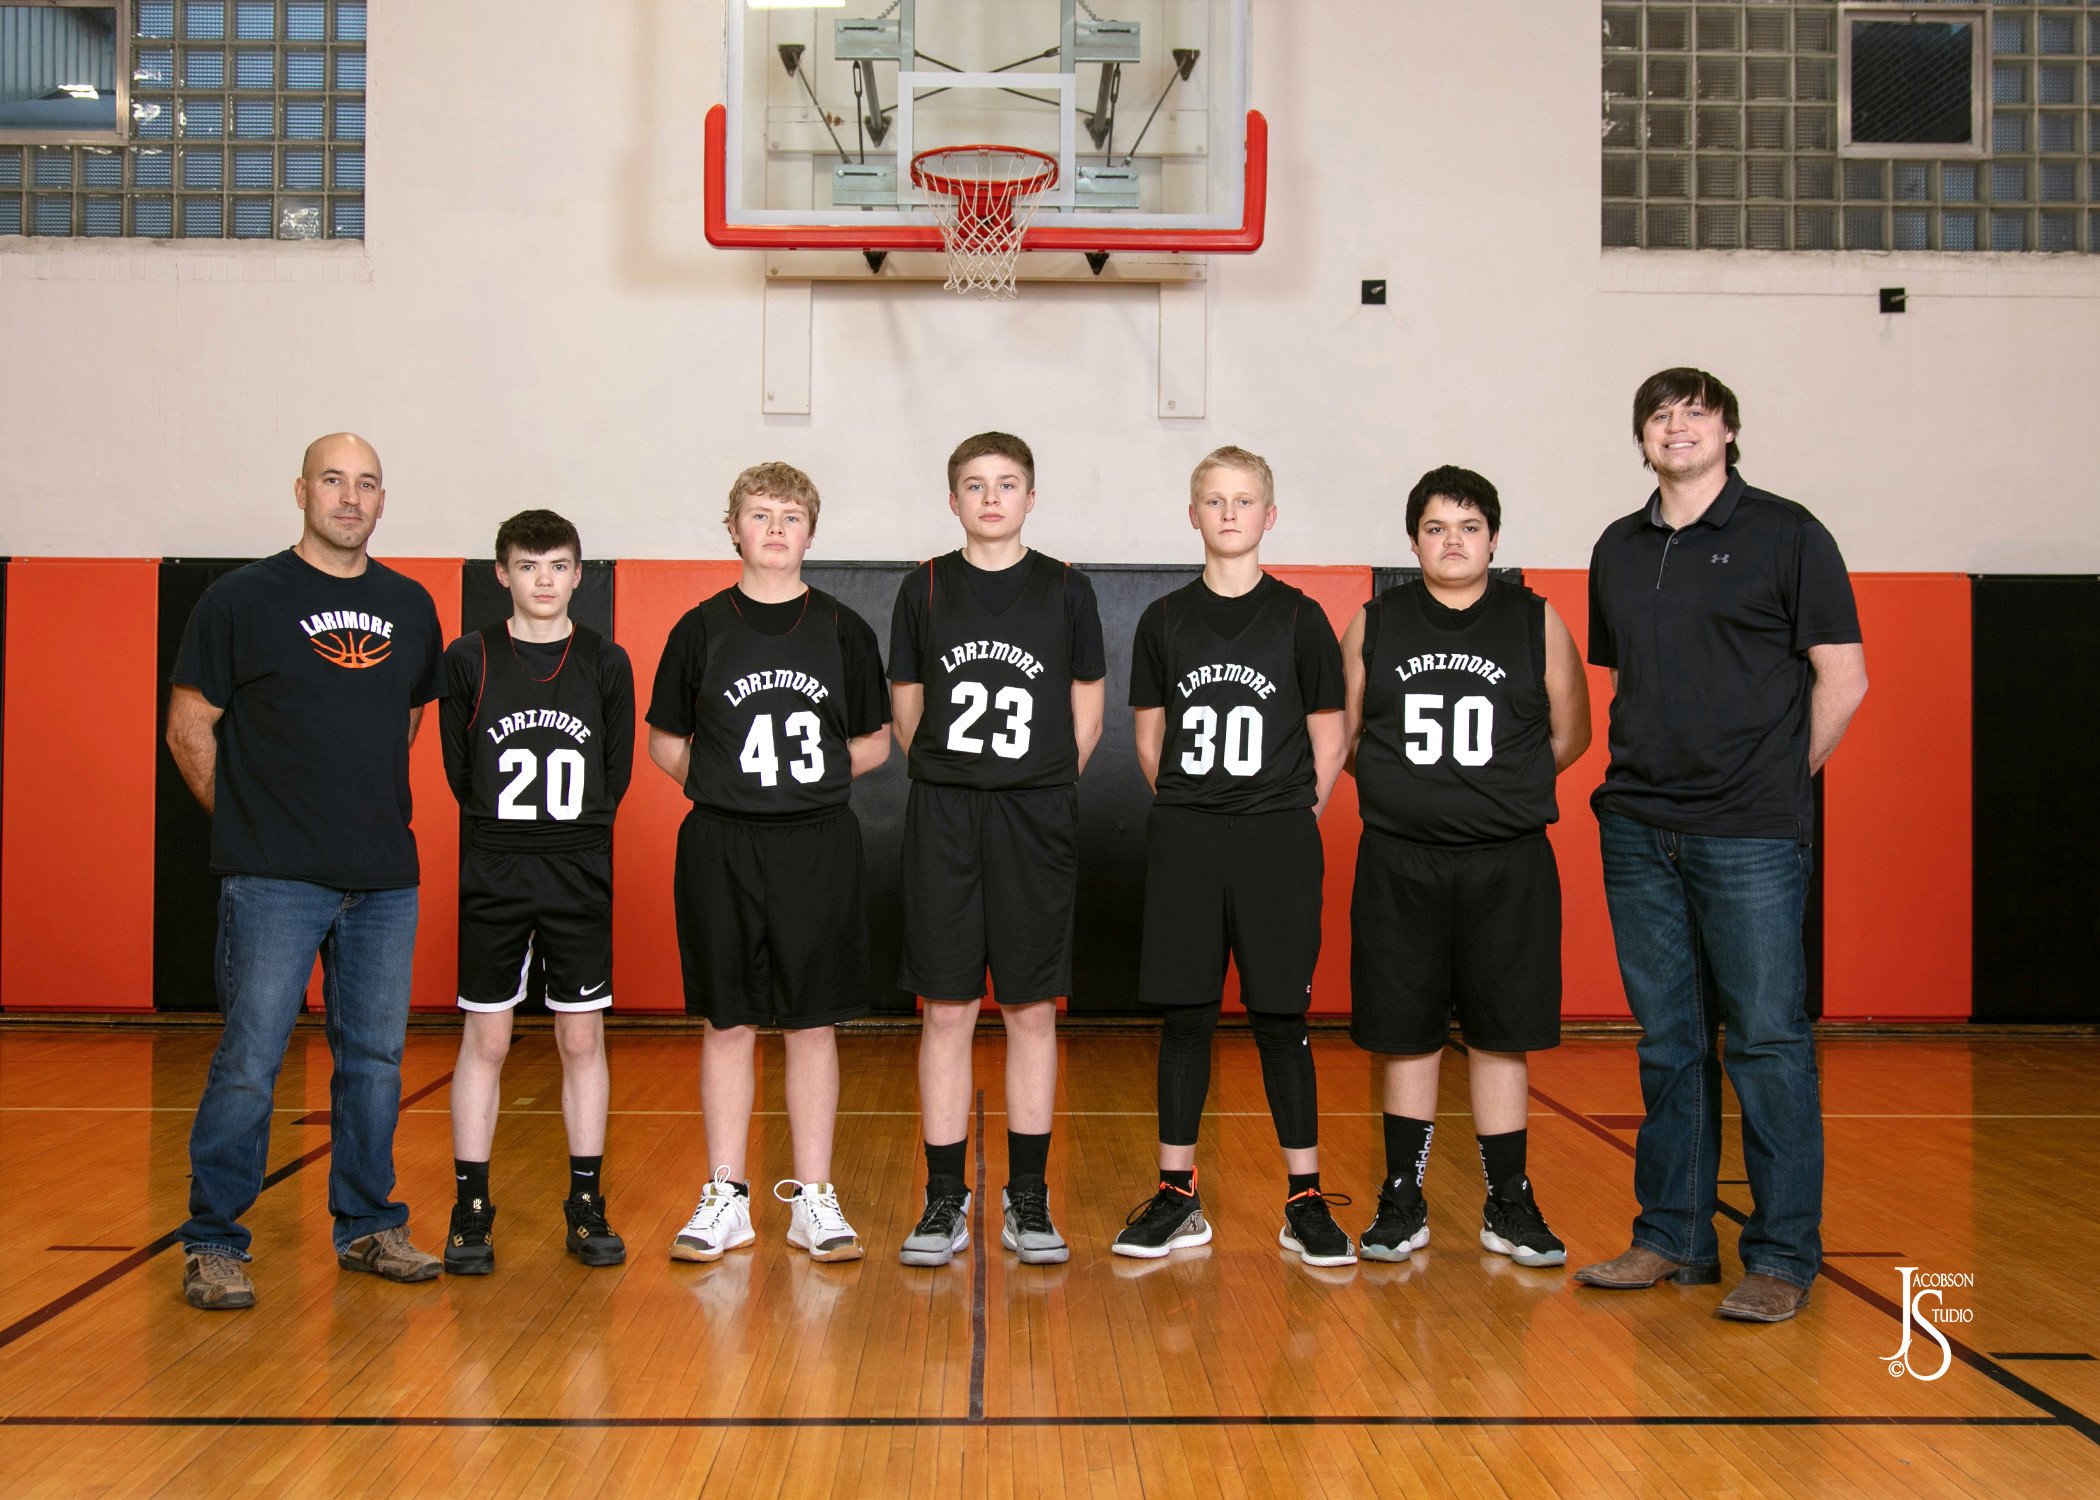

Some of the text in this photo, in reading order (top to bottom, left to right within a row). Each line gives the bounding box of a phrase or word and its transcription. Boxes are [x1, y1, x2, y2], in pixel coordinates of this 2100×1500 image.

[300, 611, 394, 640] LARIMORE
[940, 640, 1044, 680] LARIMORE
[1395, 653, 1506, 685] LARIMORE
[723, 669, 829, 708] LARIMORE
[1176, 663, 1277, 700] LARIMORE
[486, 708, 591, 745] LARIMORE
[946, 681, 1034, 760] 23
[1404, 693, 1494, 767] 50
[739, 710, 826, 787] 43
[1180, 705, 1264, 777] 30
[497, 748, 585, 821] 20
